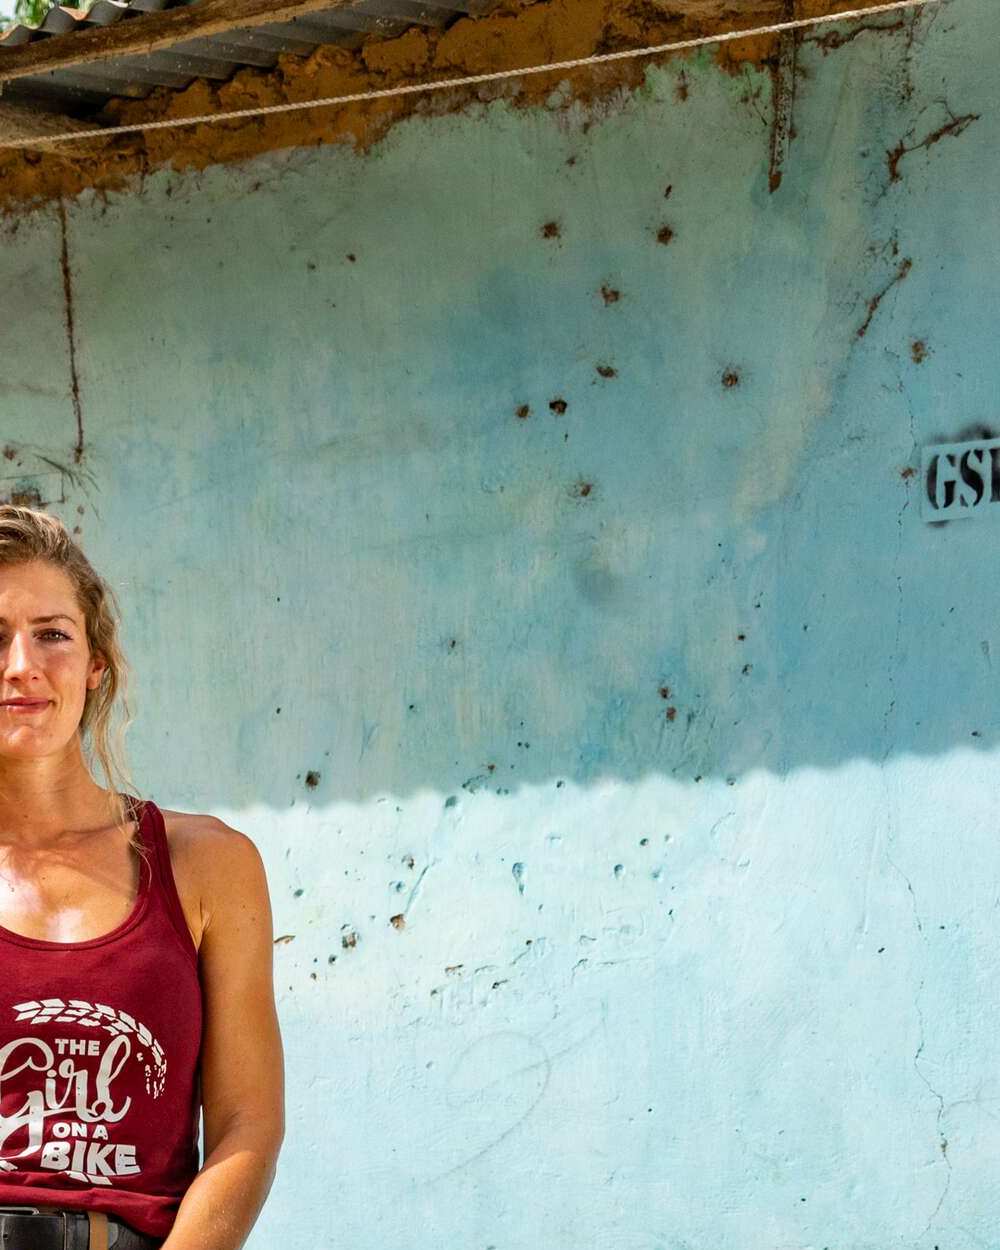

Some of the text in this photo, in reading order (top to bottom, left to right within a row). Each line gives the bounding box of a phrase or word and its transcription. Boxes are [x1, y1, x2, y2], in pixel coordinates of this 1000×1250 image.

[55, 1038, 100, 1057] THE
[52, 1121, 109, 1141] ON A
[40, 1141, 142, 1176] BIKE
